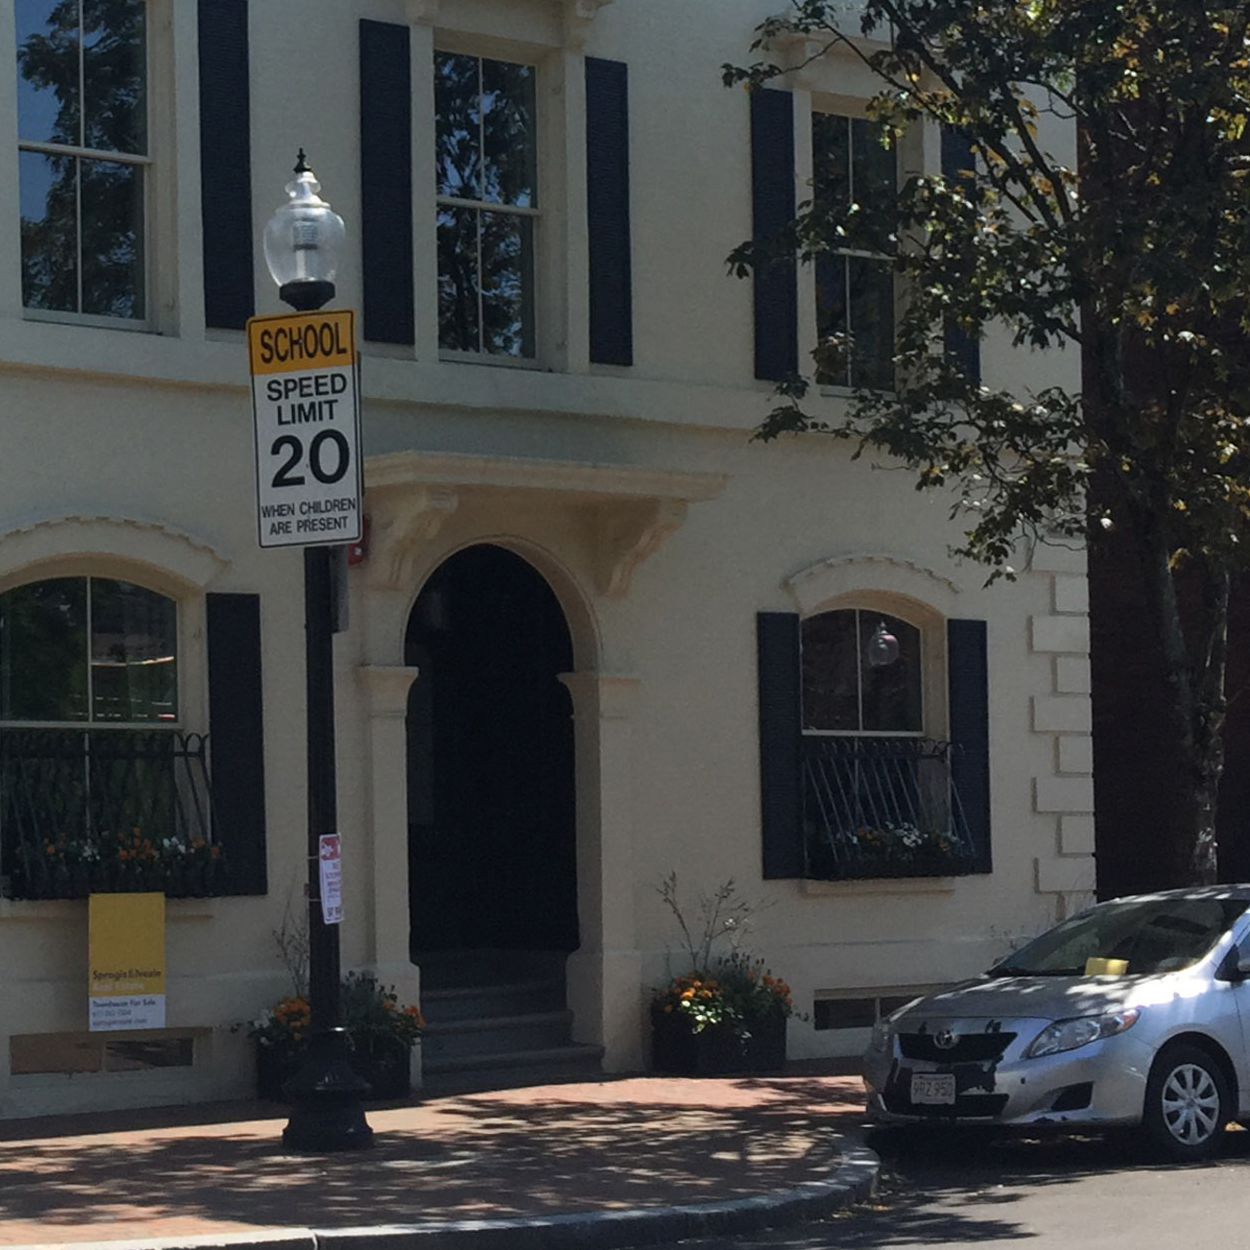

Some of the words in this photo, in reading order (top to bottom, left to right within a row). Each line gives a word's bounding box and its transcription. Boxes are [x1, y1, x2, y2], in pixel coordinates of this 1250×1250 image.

[260, 322, 347, 364] SCHOOL
[266, 373, 347, 401] SPEED
[277, 399, 338, 426] LIMIT
[270, 428, 350, 488] 20
[261, 502, 295, 519] WHEN
[299, 497, 356, 517] CHILDREN
[269, 519, 292, 535] ARE
[296, 515, 349, 533] PRESENT
